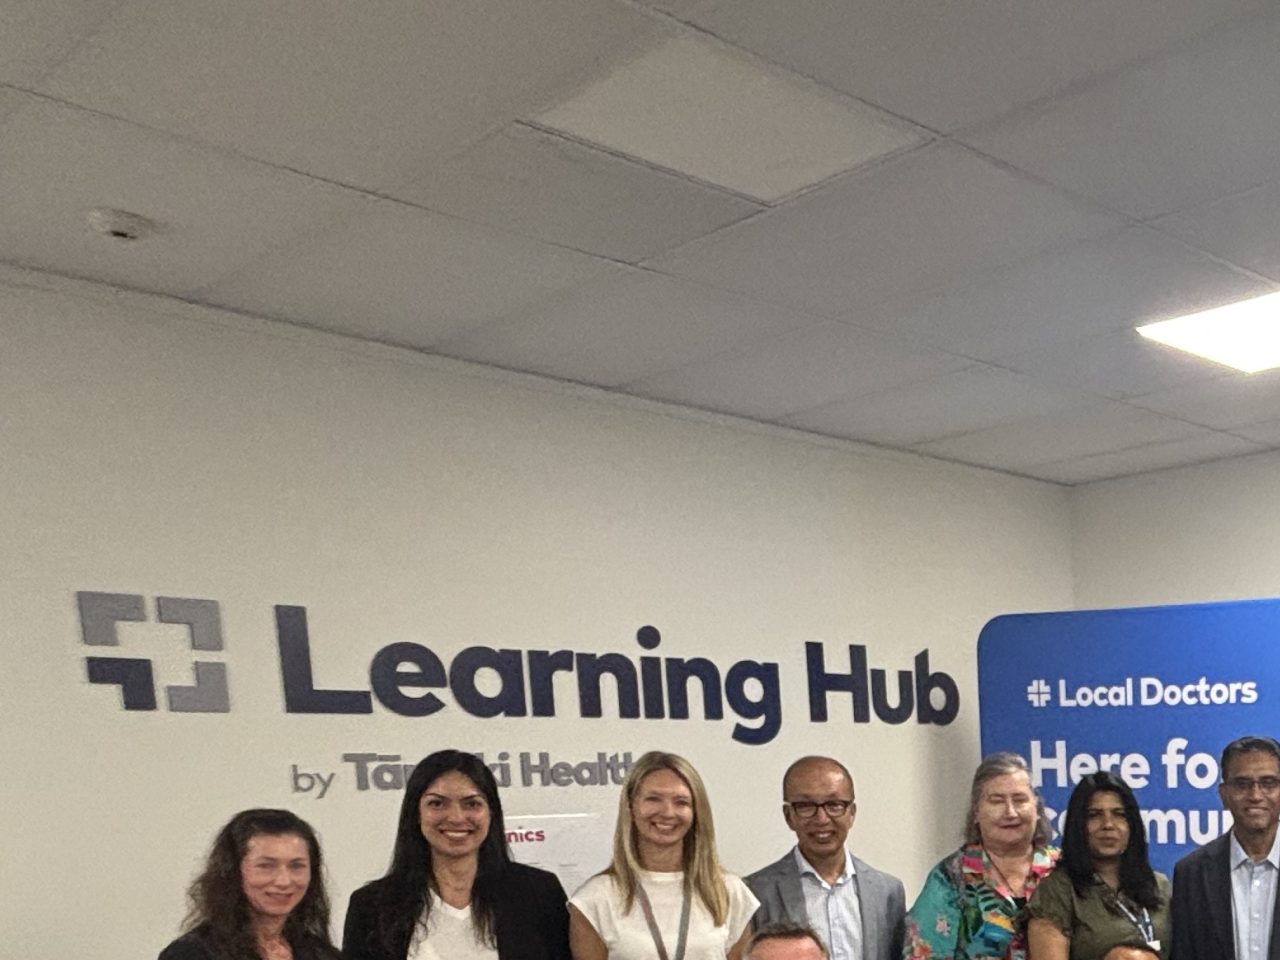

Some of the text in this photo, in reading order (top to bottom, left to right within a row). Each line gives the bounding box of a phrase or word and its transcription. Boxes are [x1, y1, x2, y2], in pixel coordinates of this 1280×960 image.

[274, 604, 960, 745] Learning Hub
[1058, 676, 1259, 707] Local Doctors
[1030, 739, 1151, 789] Here
[1161, 738, 1224, 789] fo
[290, 764, 335, 799] by
[505, 828, 546, 843] nics
